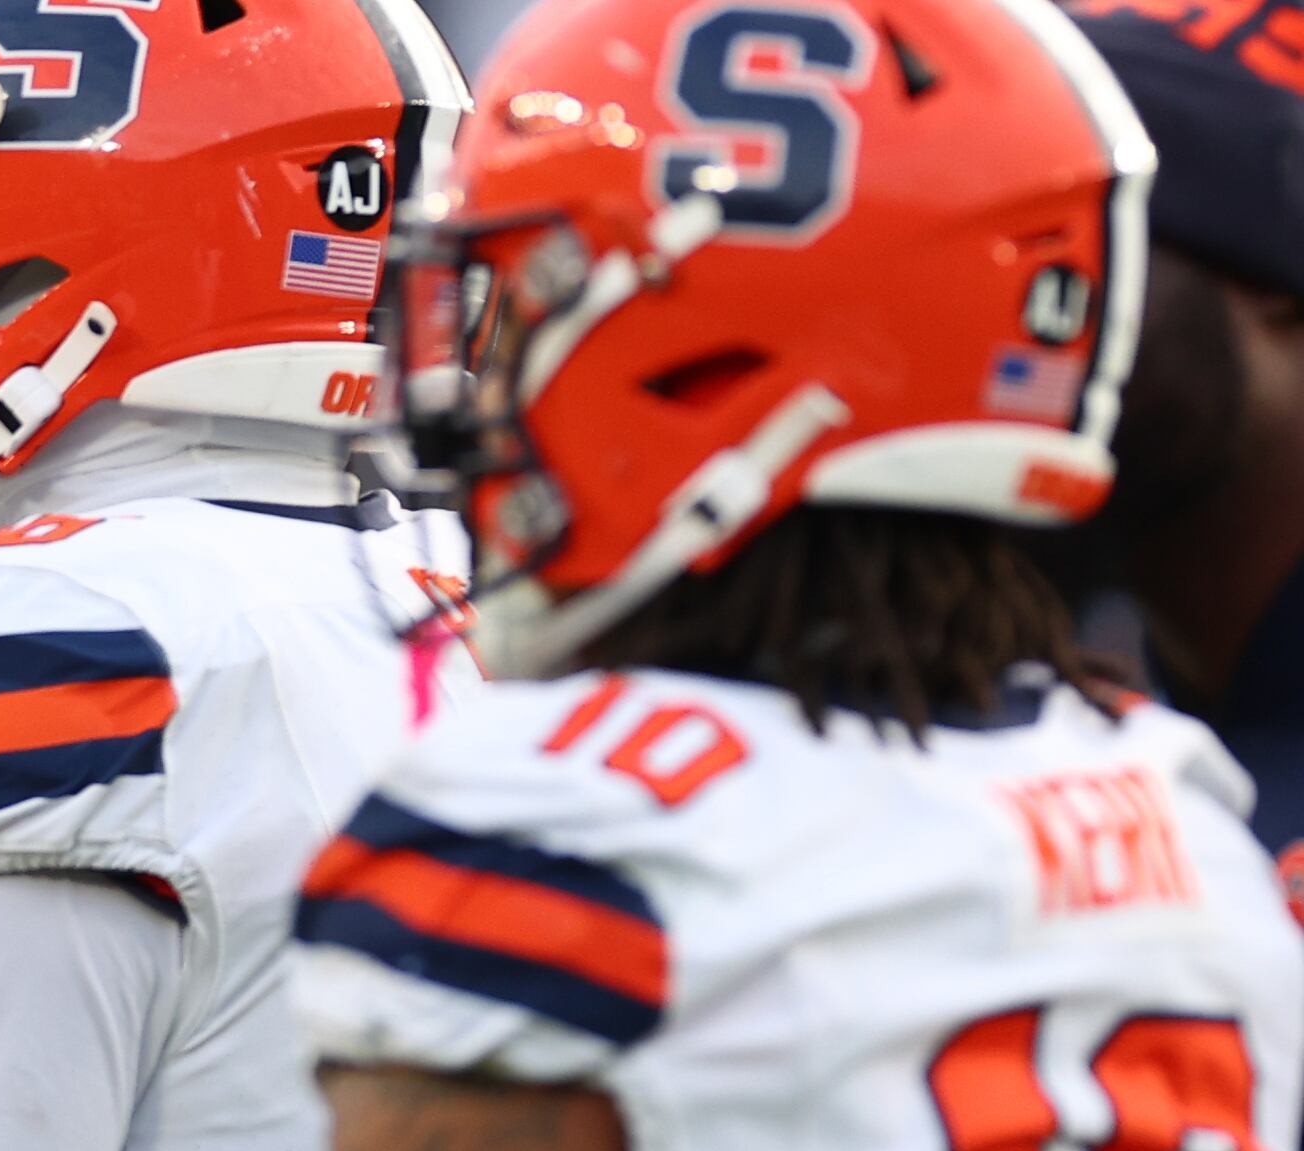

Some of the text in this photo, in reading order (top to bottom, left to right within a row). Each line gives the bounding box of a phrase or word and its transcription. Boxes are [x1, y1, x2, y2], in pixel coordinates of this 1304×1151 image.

[645, 2, 879, 247] S
[324, 160, 381, 216] AJ
[321, 370, 377, 418] OR
[540, 670, 754, 808] 10
